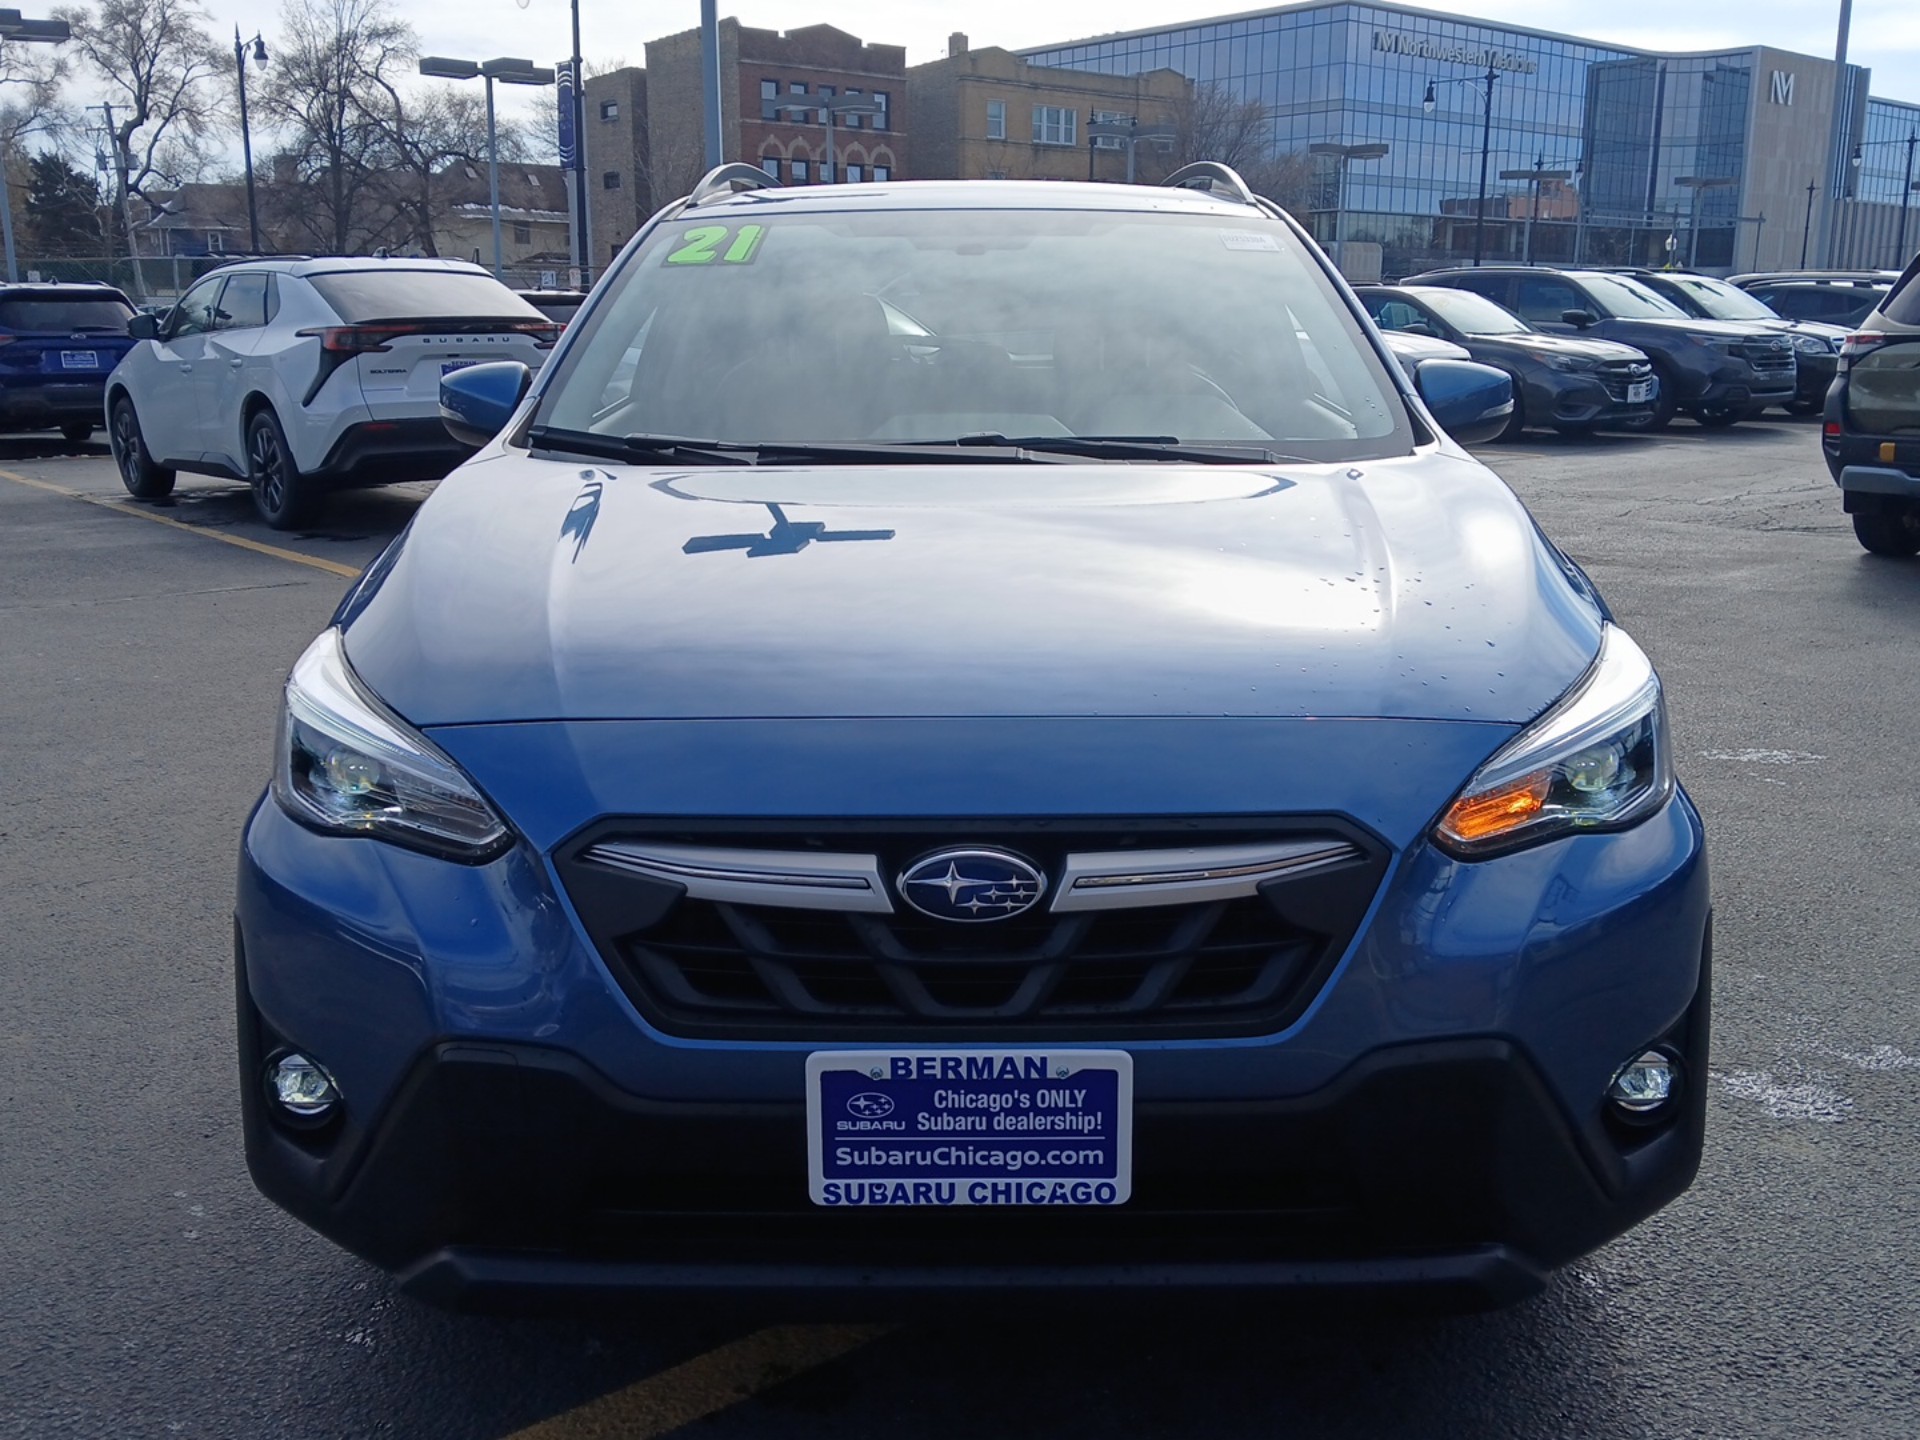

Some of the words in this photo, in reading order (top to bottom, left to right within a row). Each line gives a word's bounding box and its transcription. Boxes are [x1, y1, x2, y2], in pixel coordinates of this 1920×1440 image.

[1400, 34, 1486, 67] Northwestern
[667, 224, 766, 266] 21
[422, 336, 511, 344] SUBARU
[890, 1056, 1049, 1081] BERMAN
[933, 1088, 1031, 1113] Chicago's
[1036, 1089, 1087, 1109] ONLY
[836, 1120, 906, 1131] SUBARU
[916, 1112, 987, 1132] Subaru
[992, 1112, 1103, 1134] dealership!
[835, 1146, 1104, 1171] SubaruChicago.com
[822, 1182, 957, 1206] SUBARU
[967, 1181, 1117, 1205] CHICAGO
